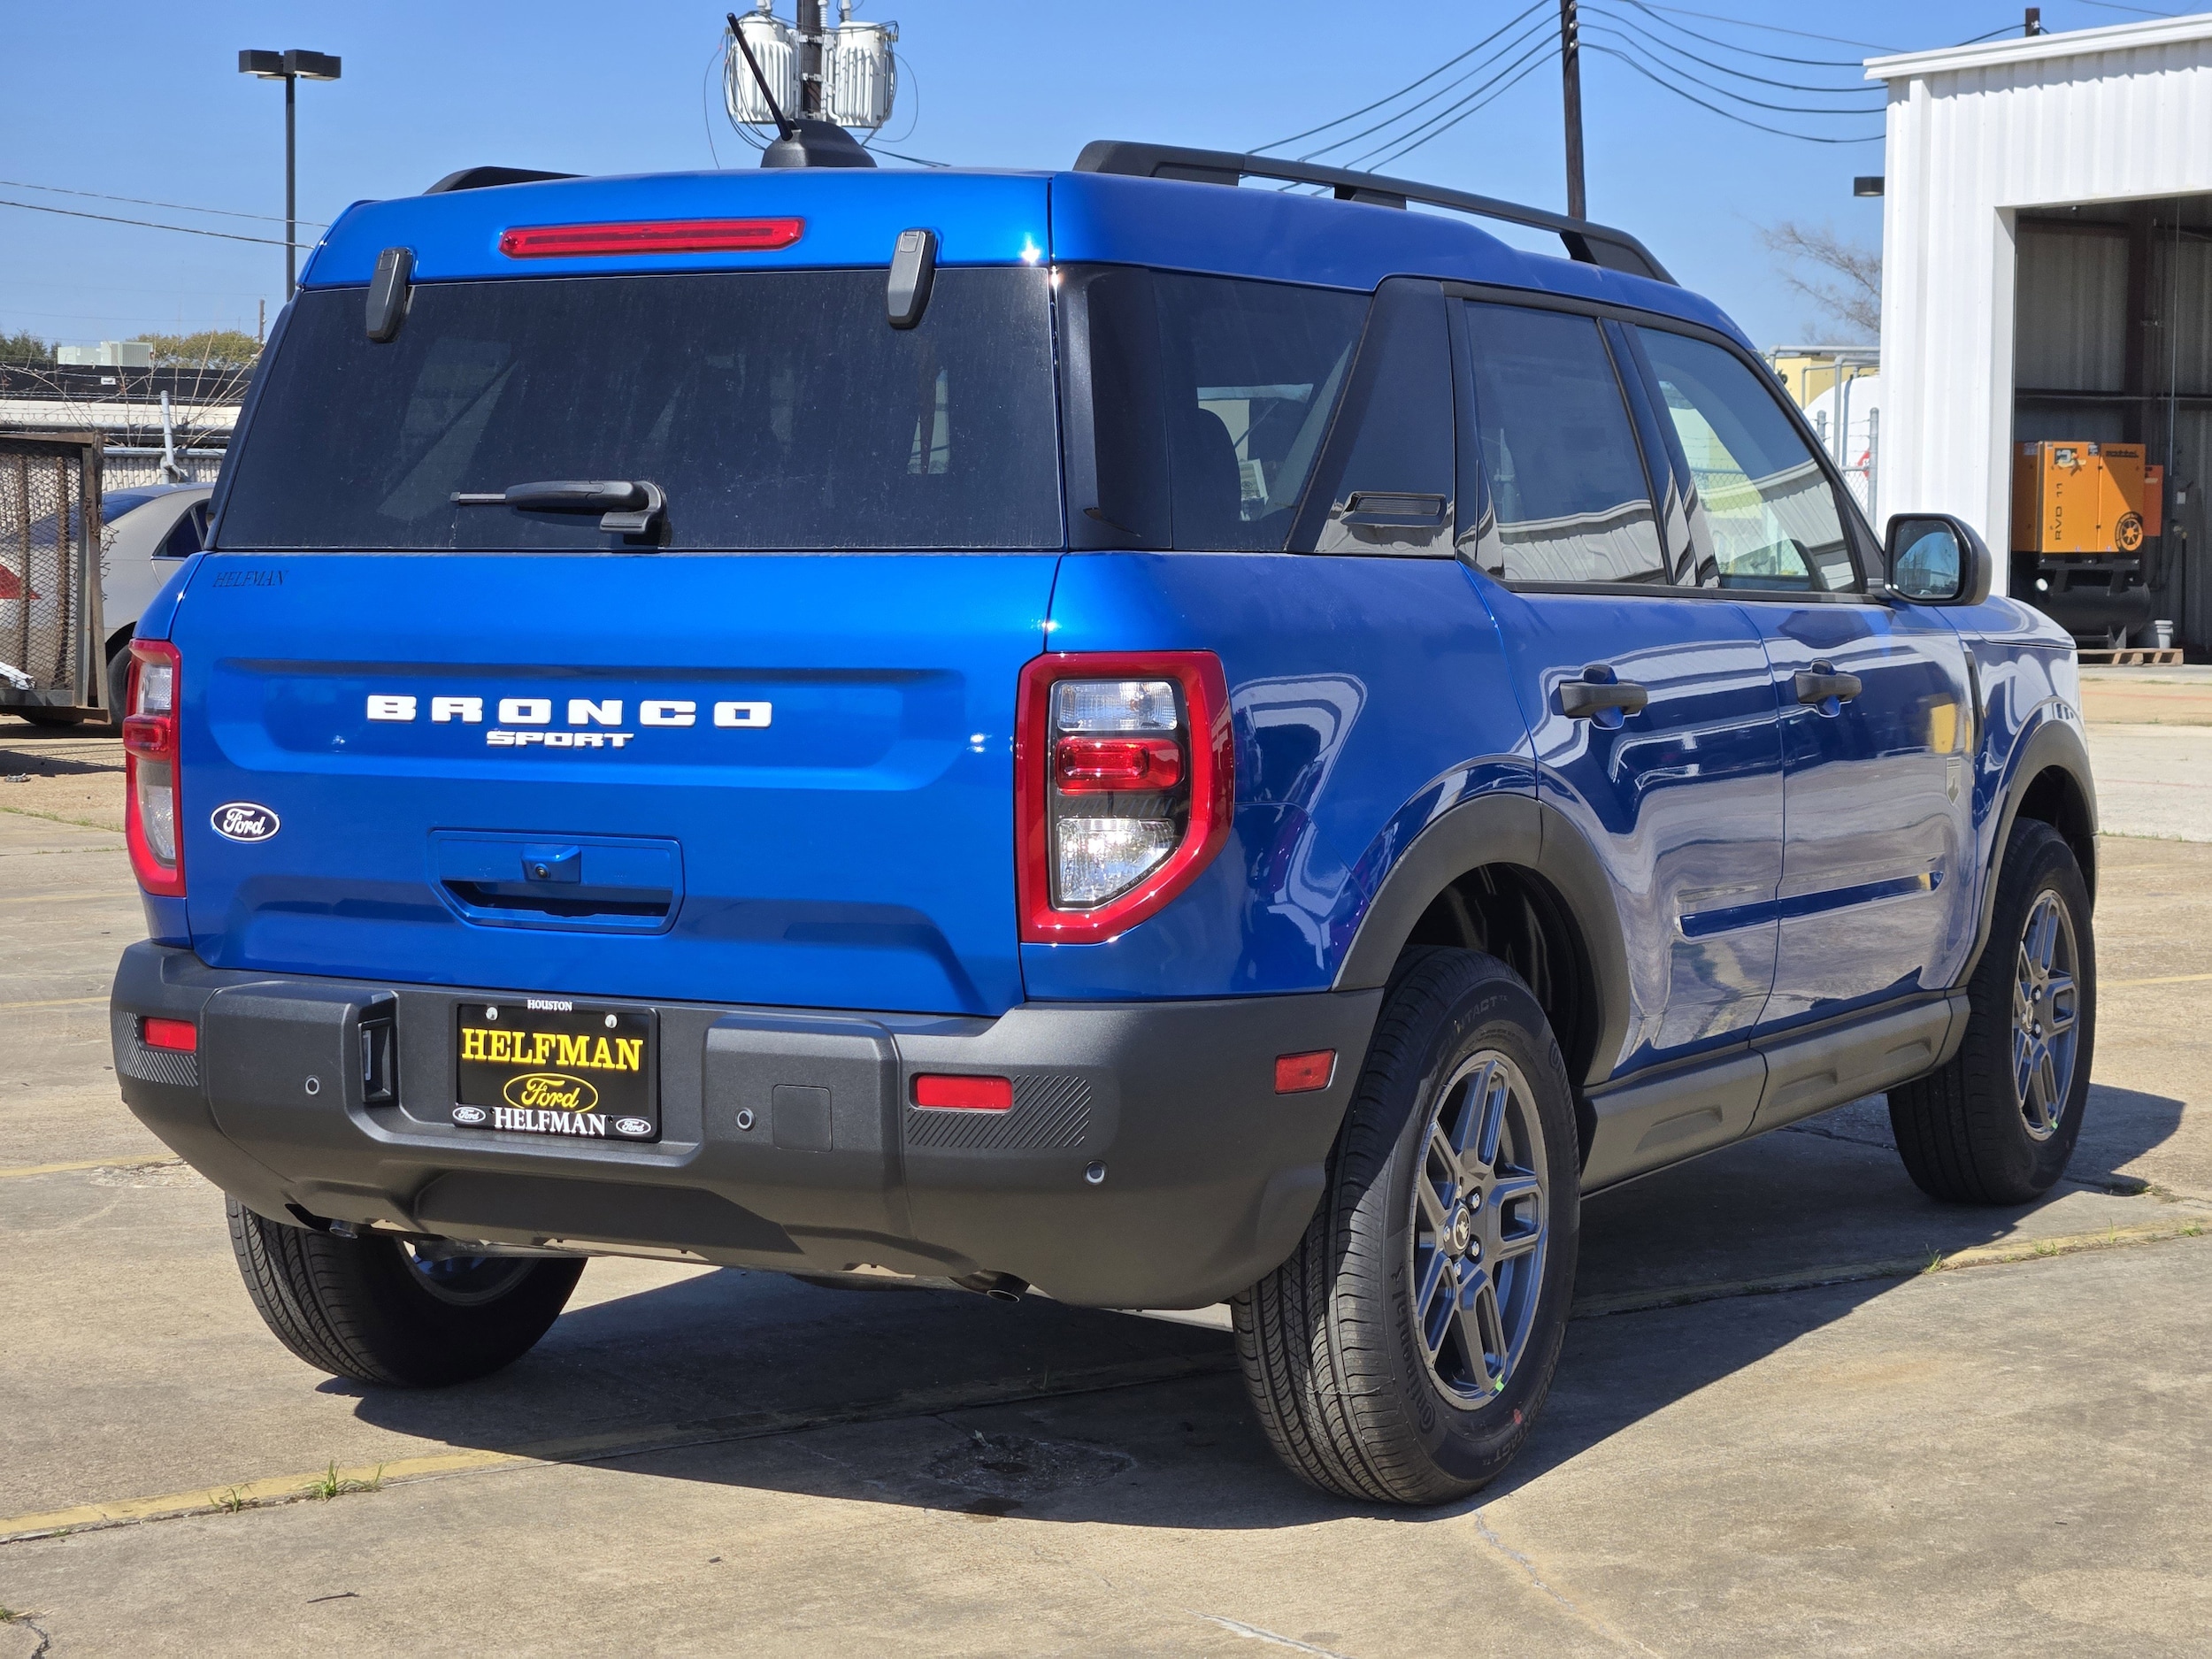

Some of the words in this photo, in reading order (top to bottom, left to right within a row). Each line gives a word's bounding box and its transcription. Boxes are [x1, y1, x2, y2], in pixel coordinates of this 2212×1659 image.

[2056, 482, 2063, 496] 11
[212, 570, 289, 588] HELFMAN
[366, 695, 772, 728] BRONCO
[487, 730, 634, 749] SPORT
[223, 808, 266, 835] Ford
[527, 999, 572, 1011] HOUSTON
[462, 1028, 643, 1071] HELFMAN
[521, 1077, 580, 1108] Ford
[458, 1109, 480, 1119] Ford
[494, 1106, 607, 1135] HELFMAN
[622, 1120, 645, 1132] Ford
